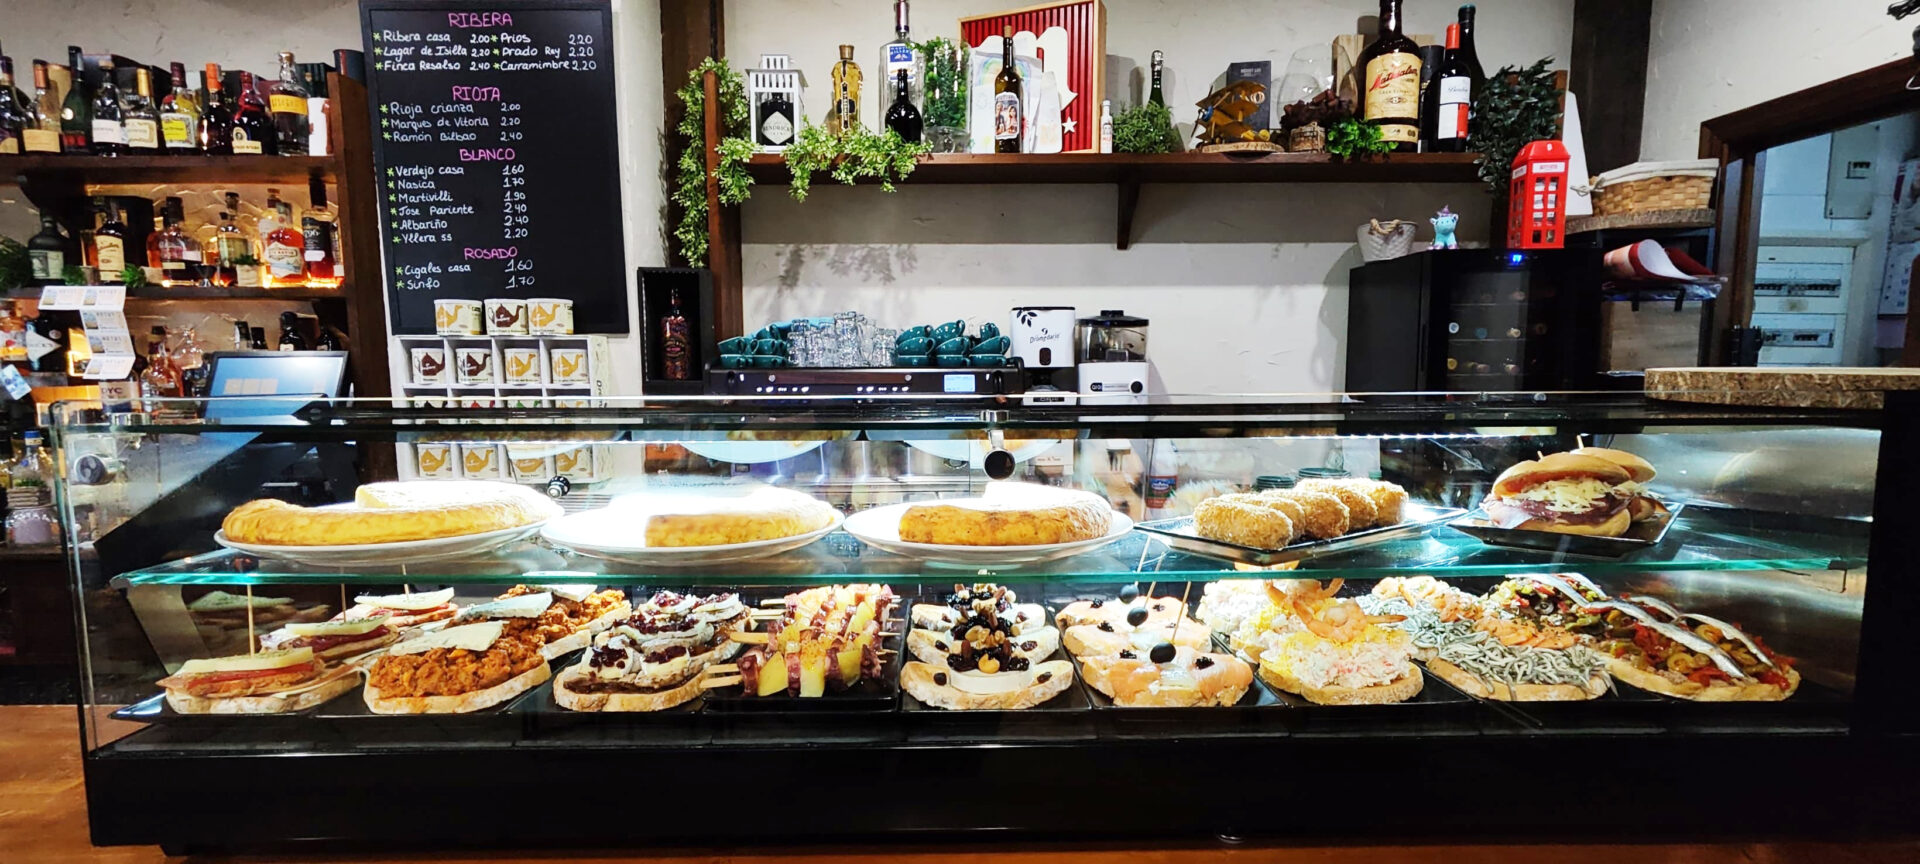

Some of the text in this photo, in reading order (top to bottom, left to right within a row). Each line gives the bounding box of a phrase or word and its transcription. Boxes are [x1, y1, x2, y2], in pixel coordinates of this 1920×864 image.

[448, 13, 513, 28] RIBERA
[384, 31, 421, 42] Ribera
[427, 33, 450, 42] casa
[384, 46, 415, 62] Lagar
[421, 46, 433, 56] de
[502, 46, 538, 57] Prado
[545, 47, 560, 58] Rey
[384, 61, 415, 71] Finca
[500, 60, 569, 70] Carramimbre
[452, 86, 500, 101] RIOJA
[390, 103, 422, 122] Rioja
[431, 103, 474, 113] crianza
[391, 118, 432, 133] Marques
[437, 117, 450, 127] de
[440, 132, 476, 140] Bilbao
[460, 148, 515, 161] BLANCO
[395, 165, 434, 178] Verdejo
[439, 166, 464, 174] casa
[398, 179, 435, 190] Nasica
[398, 206, 420, 216] Jose
[464, 247, 518, 260] ROSADO
[405, 263, 441, 279] Cigales
[448, 264, 471, 273] casa
